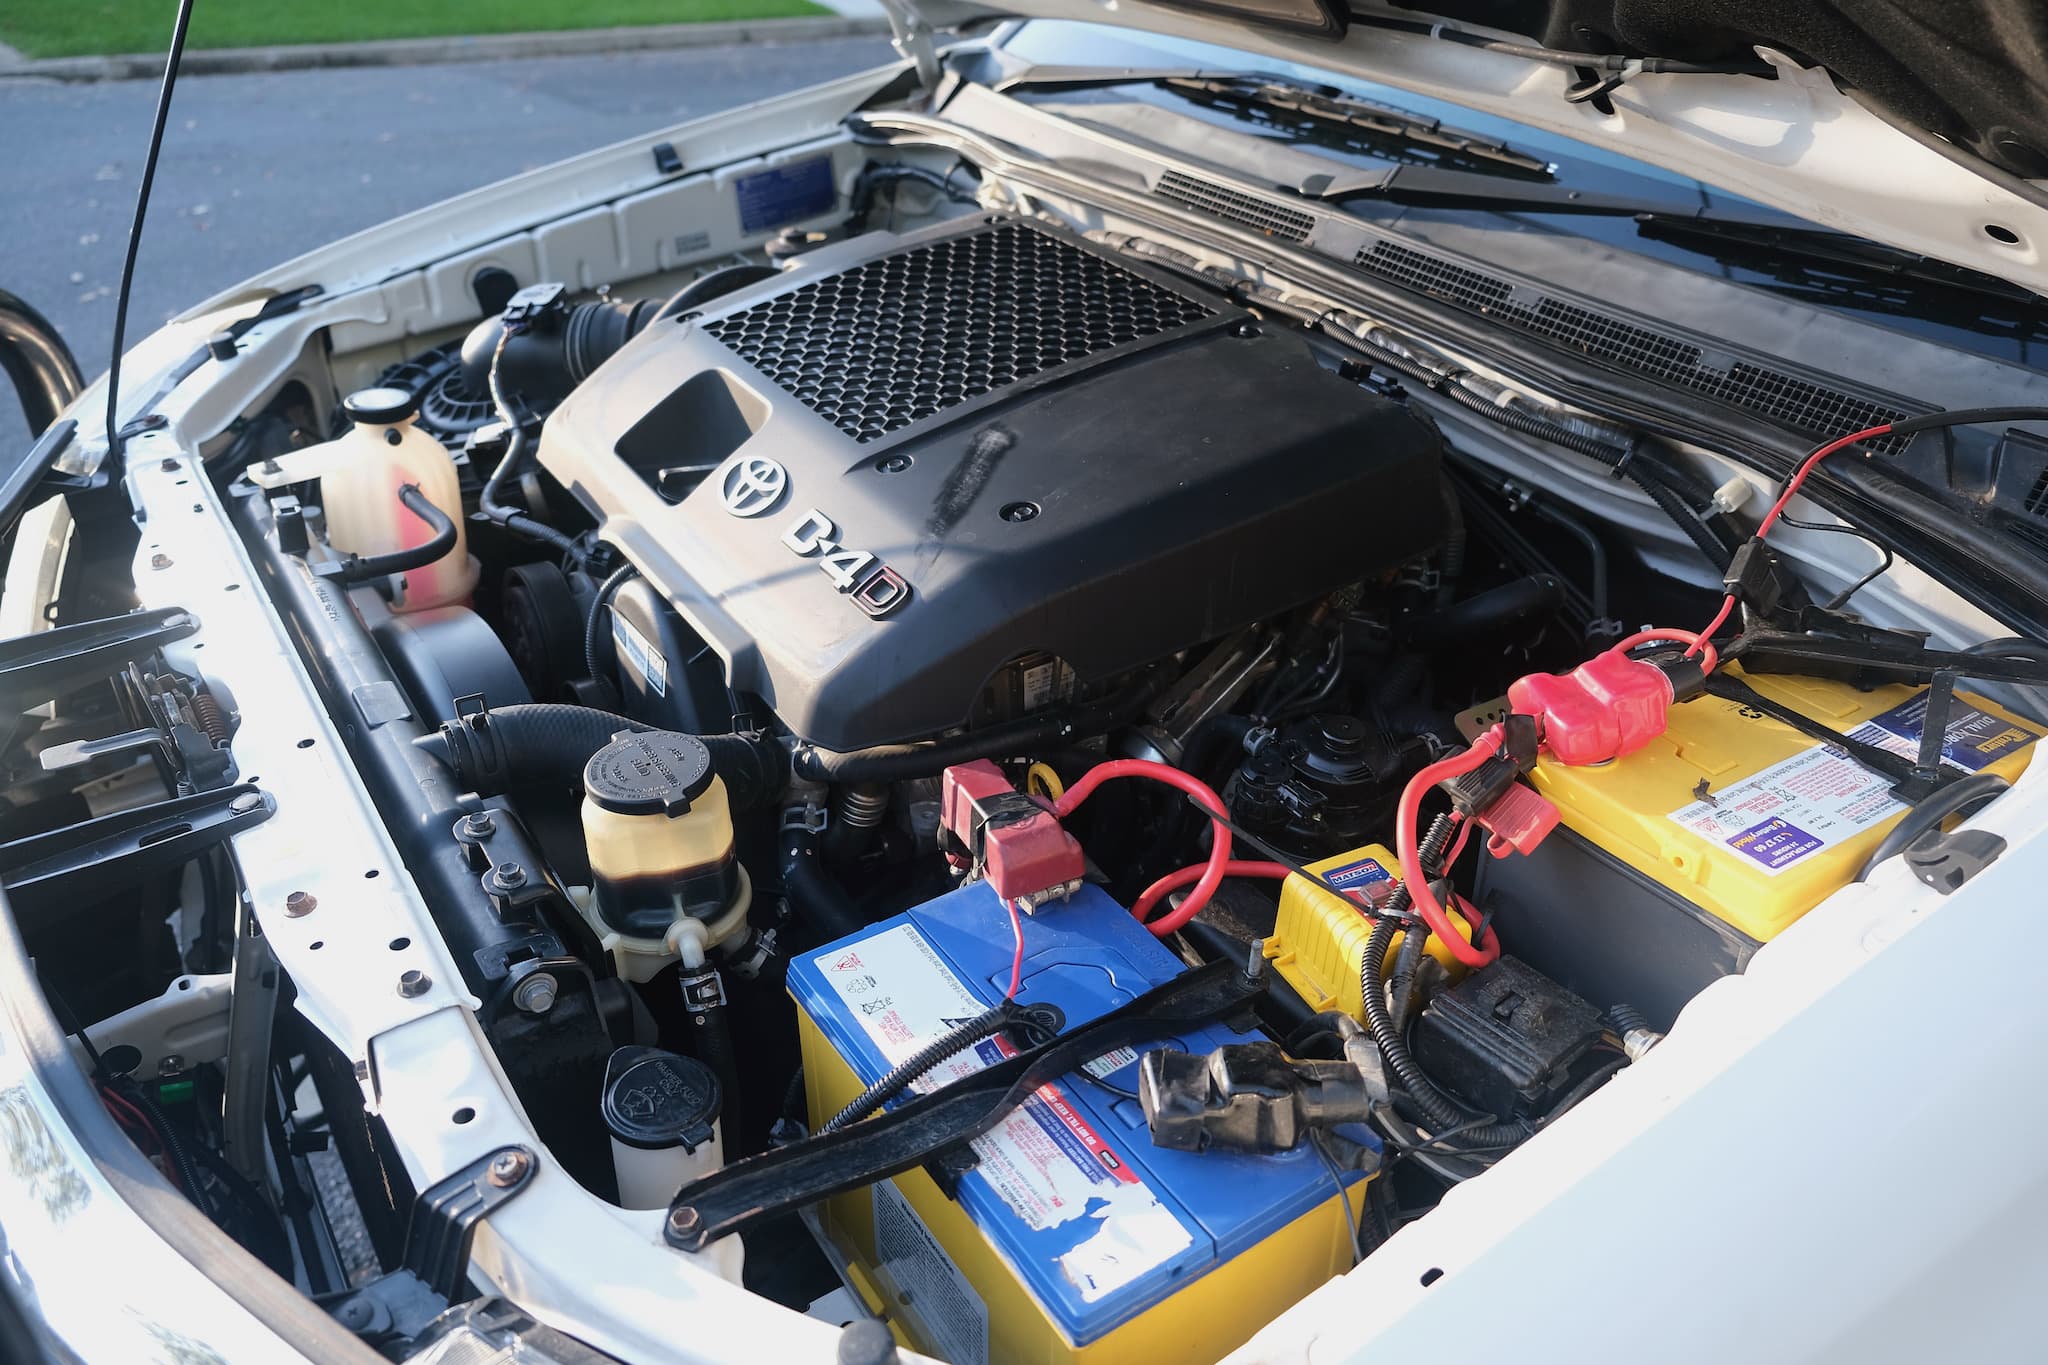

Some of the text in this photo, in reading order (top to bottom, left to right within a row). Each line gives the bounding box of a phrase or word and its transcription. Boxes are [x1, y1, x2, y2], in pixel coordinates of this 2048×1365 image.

[1964, 716, 1996, 732] DUAL
[1765, 838, 1776, 848] 17
[1773, 835, 1786, 843] 13
[1769, 845, 1807, 866] REPLACEMENT
[1771, 844, 1792, 856] HOURS
[1333, 865, 1378, 884] MATSON
